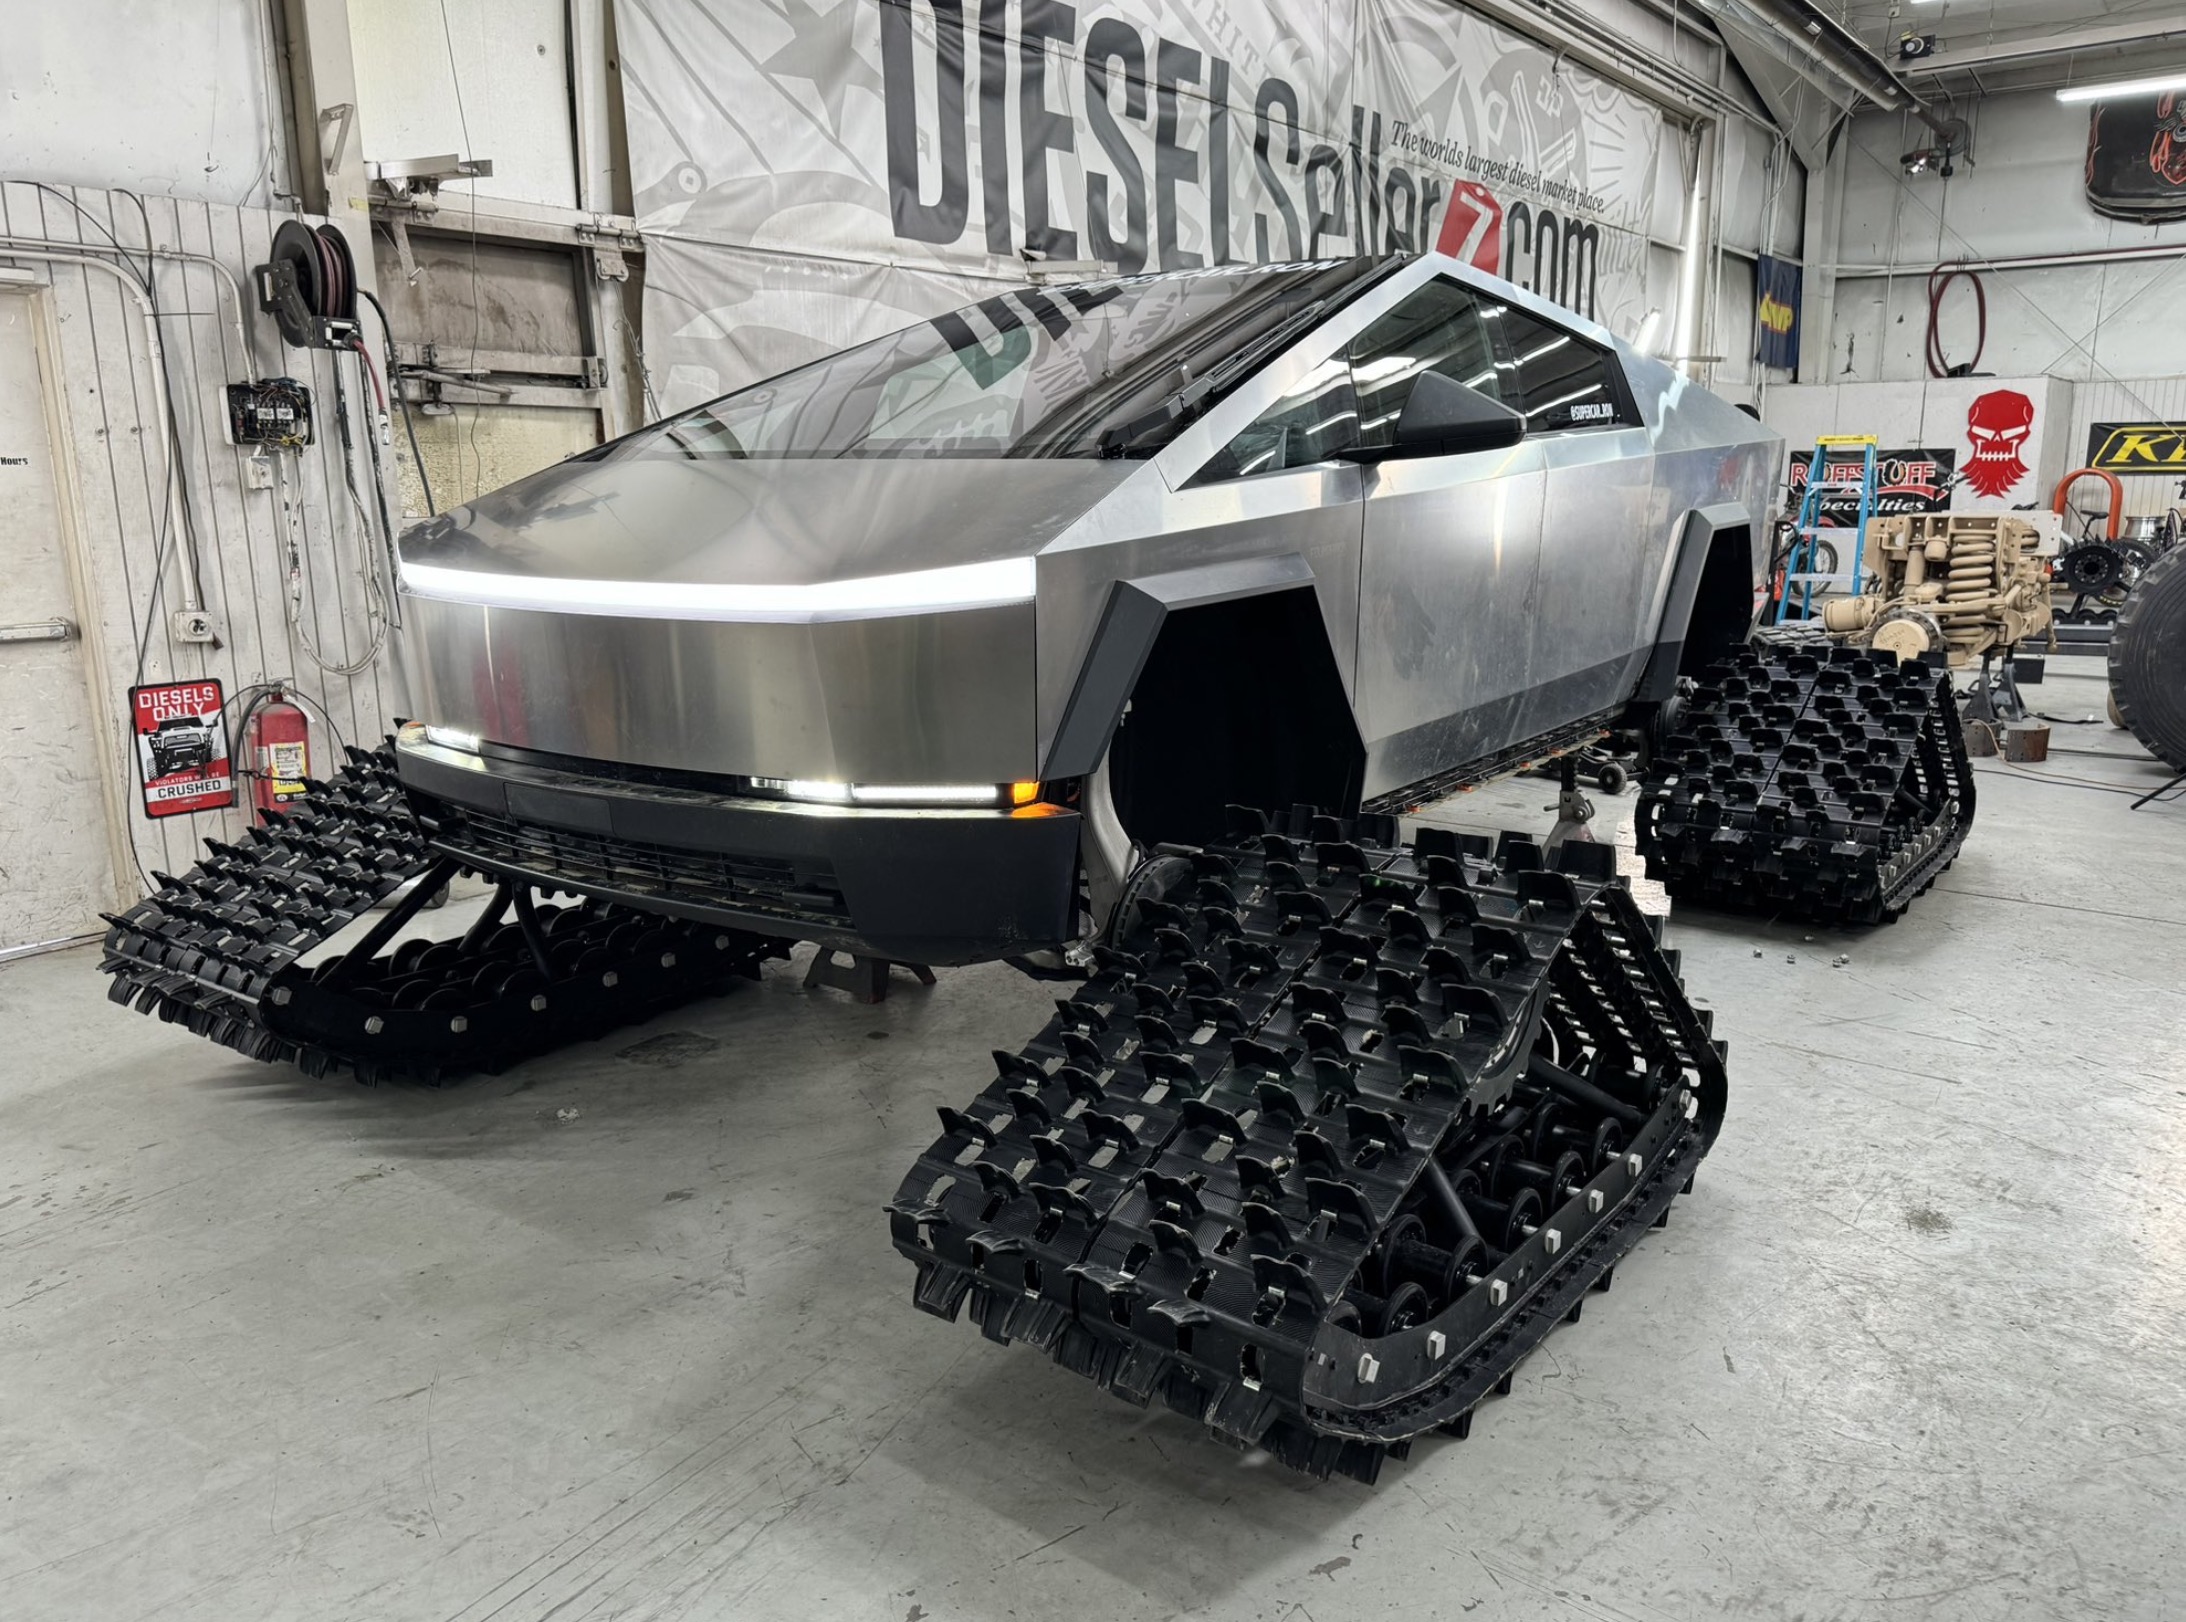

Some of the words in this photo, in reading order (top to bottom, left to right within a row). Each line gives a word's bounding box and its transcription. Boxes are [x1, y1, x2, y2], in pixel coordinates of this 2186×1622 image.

[1391, 120, 1418, 150] The
[1419, 136, 1463, 168] worlds
[1464, 146, 1509, 181] largest
[1509, 159, 1542, 195] diesel
[1542, 179, 1577, 206] market
[1577, 189, 1605, 214] place.
[0, 456, 29, 466] Hours
[138, 686, 215, 709] DIESELS
[152, 702, 204, 722] ONLY
[155, 775, 194, 787] VIOLATORS
[157, 779, 222, 800] CRUSHED
